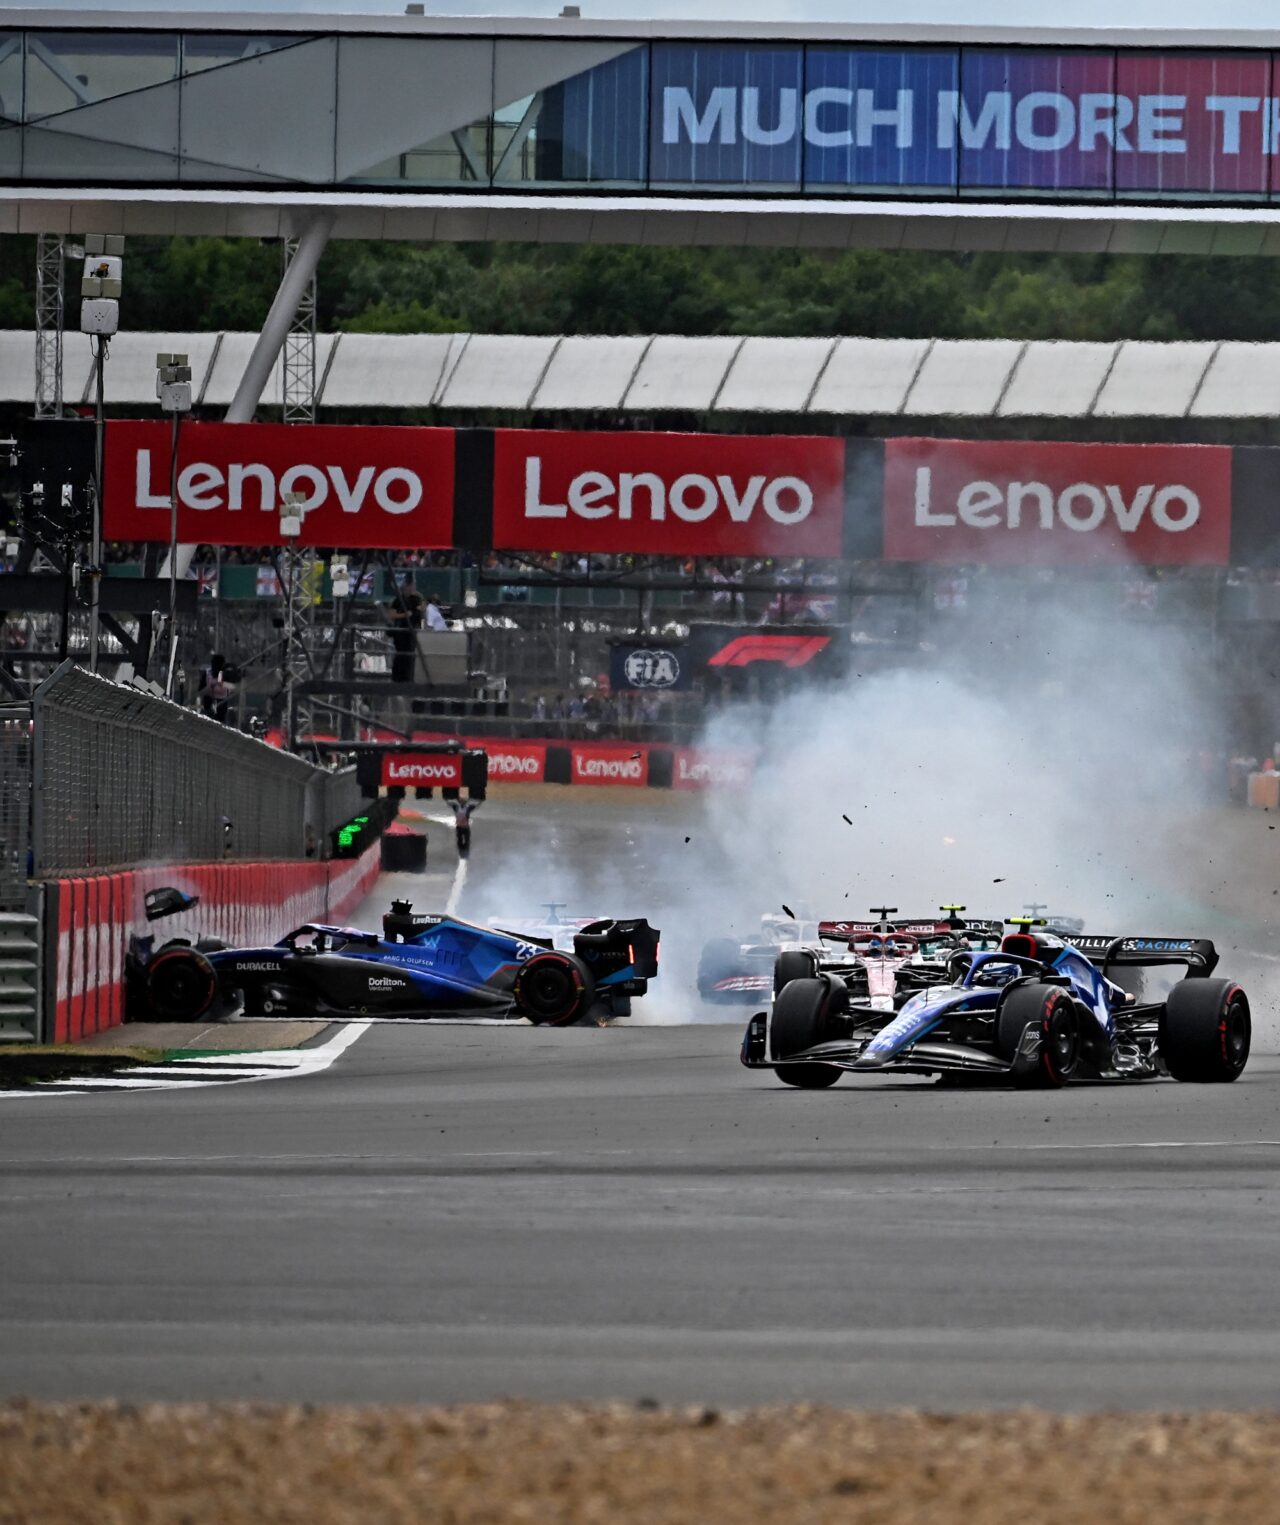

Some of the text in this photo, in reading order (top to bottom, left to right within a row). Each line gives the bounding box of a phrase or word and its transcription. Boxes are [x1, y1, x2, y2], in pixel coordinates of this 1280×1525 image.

[662, 86, 914, 149] MUCH
[937, 90, 1187, 154] MORE
[135, 448, 423, 515] Lenovo
[524, 456, 814, 525] Lenovo
[914, 466, 1201, 533] Lenovo
[388, 762, 457, 779] Lenovo
[487, 754, 539, 775] enovo
[576, 755, 642, 778] Lenovo
[516, 942, 535, 960] 23
[1136, 940, 1190, 950] RACING
[236, 962, 281, 970] DURACELL
